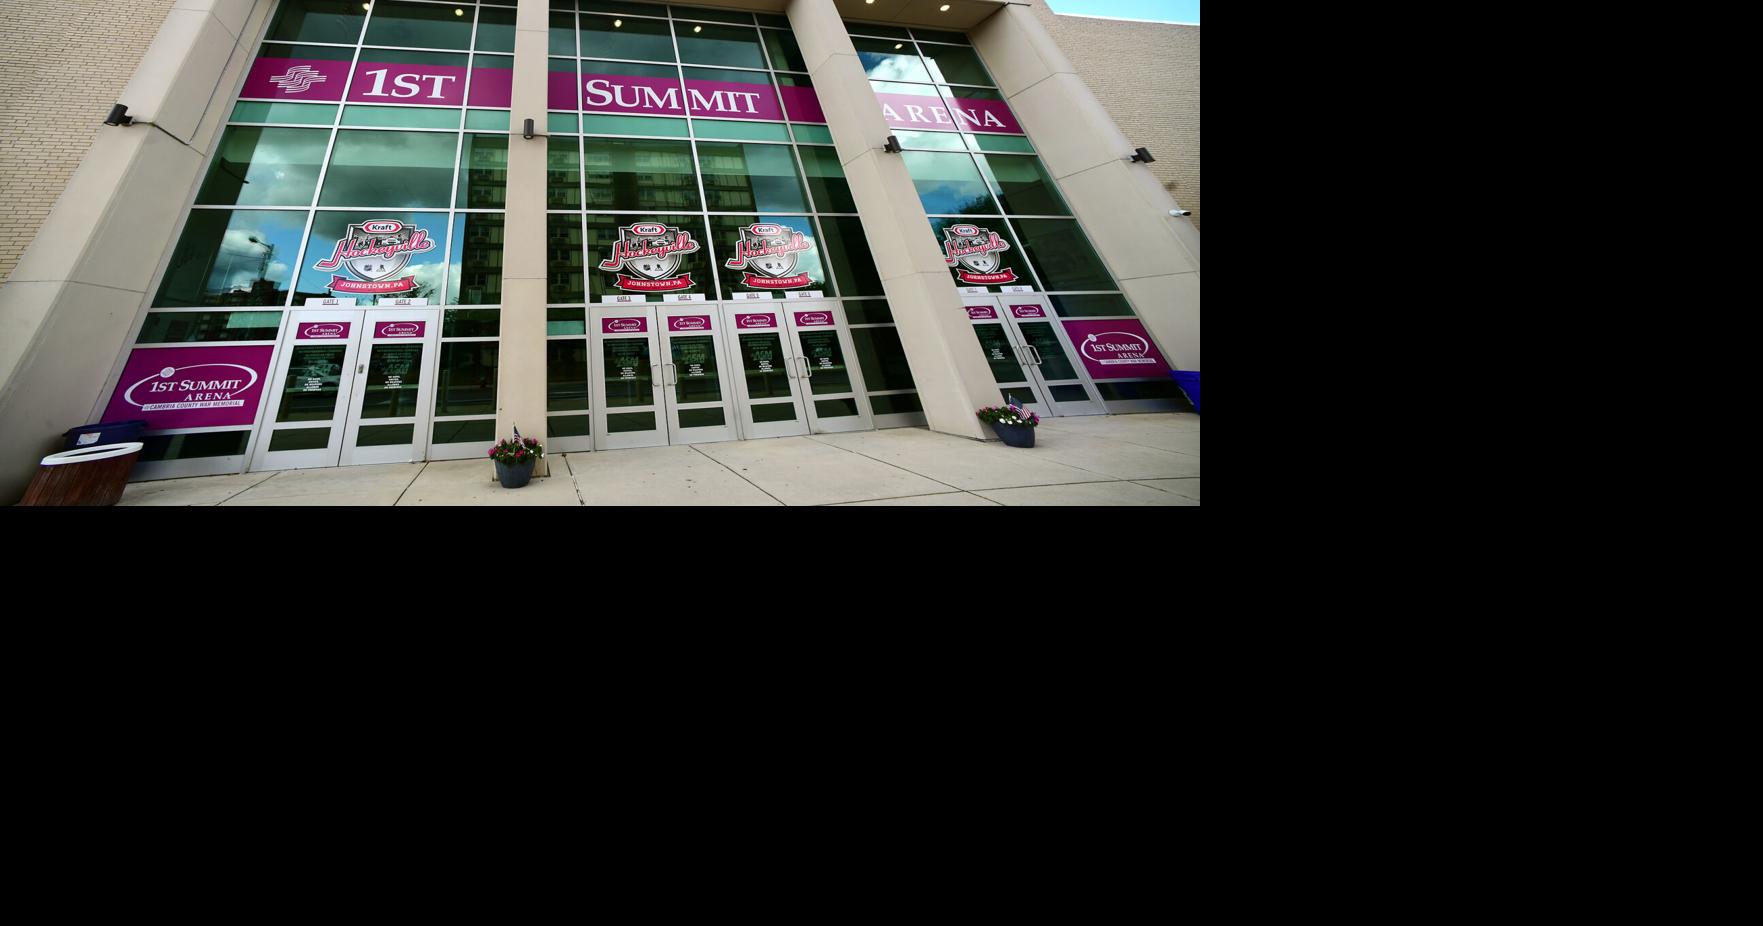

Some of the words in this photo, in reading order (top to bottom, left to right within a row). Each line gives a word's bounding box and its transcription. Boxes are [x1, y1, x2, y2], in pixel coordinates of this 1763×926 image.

[362, 68, 456, 99] 1ST
[586, 79, 760, 114] SUMMIT
[882, 103, 1007, 128] ARENA
[318, 231, 430, 267] Hockeyville
[602, 232, 694, 267] Hockeyville
[728, 233, 809, 266] Hockeyville
[1091, 344, 1107, 352] 1ST
[1106, 343, 1141, 351] SUMMIT
[150, 381, 178, 392] 1ST
[178, 379, 242, 391] SUMMIT
[184, 392, 232, 401] ARENA
